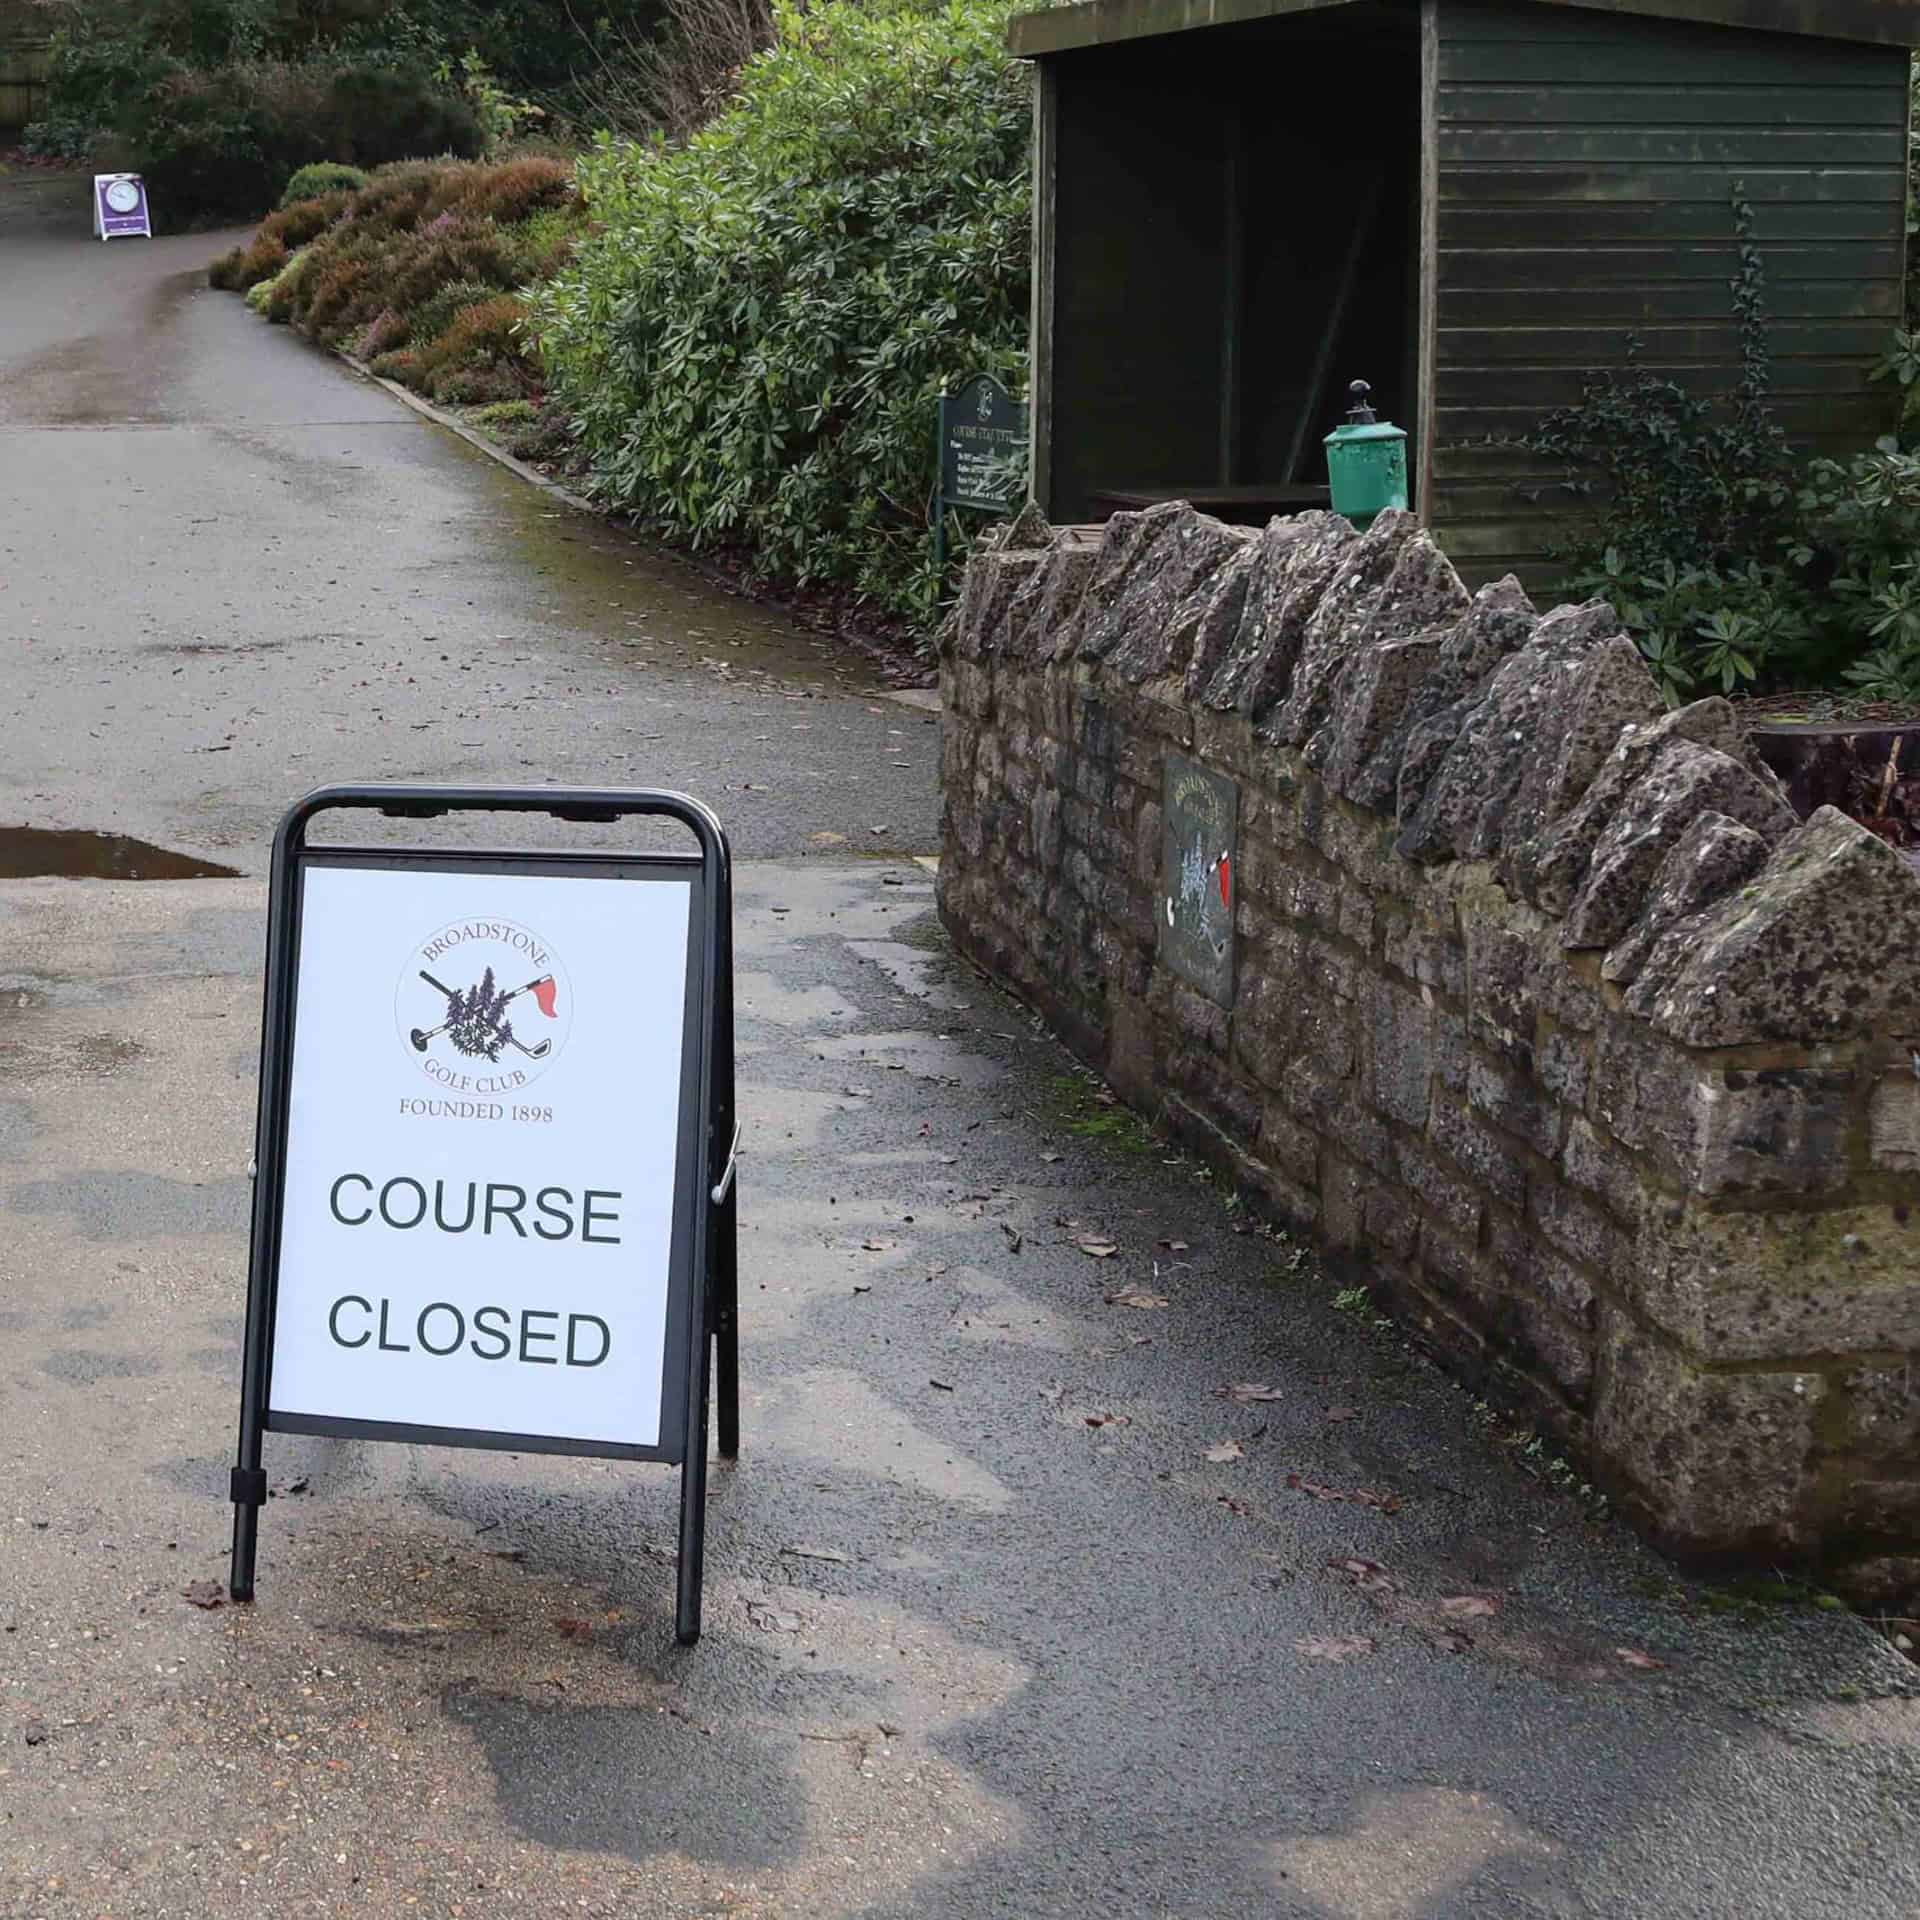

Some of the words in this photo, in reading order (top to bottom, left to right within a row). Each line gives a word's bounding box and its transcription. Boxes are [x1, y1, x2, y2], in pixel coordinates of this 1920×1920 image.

[422, 922, 551, 969] BROADSTONE
[423, 1057, 472, 1091] GOLF
[475, 1068, 527, 1094] CLUB
[399, 1098, 504, 1121] FOUNDED
[511, 1104, 554, 1123] 1898
[329, 1173, 623, 1245] COURSE
[328, 1295, 611, 1368] CLOSED
